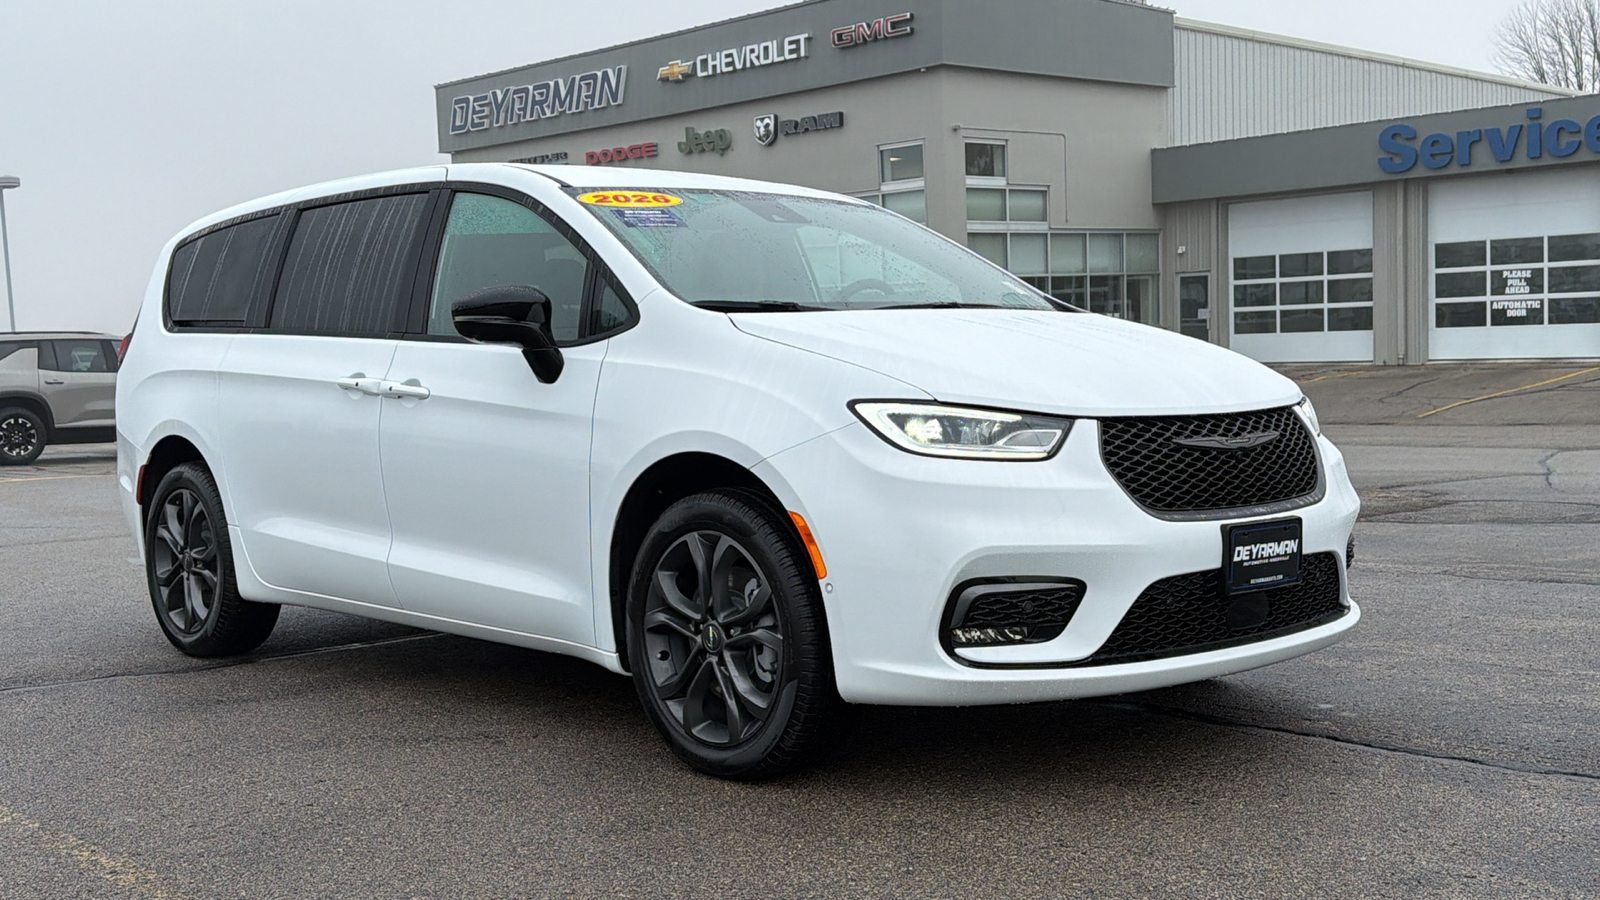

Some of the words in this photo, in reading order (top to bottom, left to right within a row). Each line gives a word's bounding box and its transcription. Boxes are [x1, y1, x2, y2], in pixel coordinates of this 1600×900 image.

[830, 12, 914, 48] GMC
[695, 32, 811, 78] CHEVROLET
[449, 65, 627, 135] DEYARMAN
[778, 111, 844, 136] RAM
[677, 126, 732, 156] Jeep
[585, 142, 658, 166] DODGE
[592, 194, 671, 204] 2026
[1502, 270, 1532, 278] PLEASE
[1507, 278, 1527, 286] PULL
[1504, 286, 1530, 294] AHEAD
[1492, 300, 1541, 309] AUTOMATIC
[1507, 309, 1527, 317] DOOR
[1233, 539, 1299, 562] DEYARMAN
